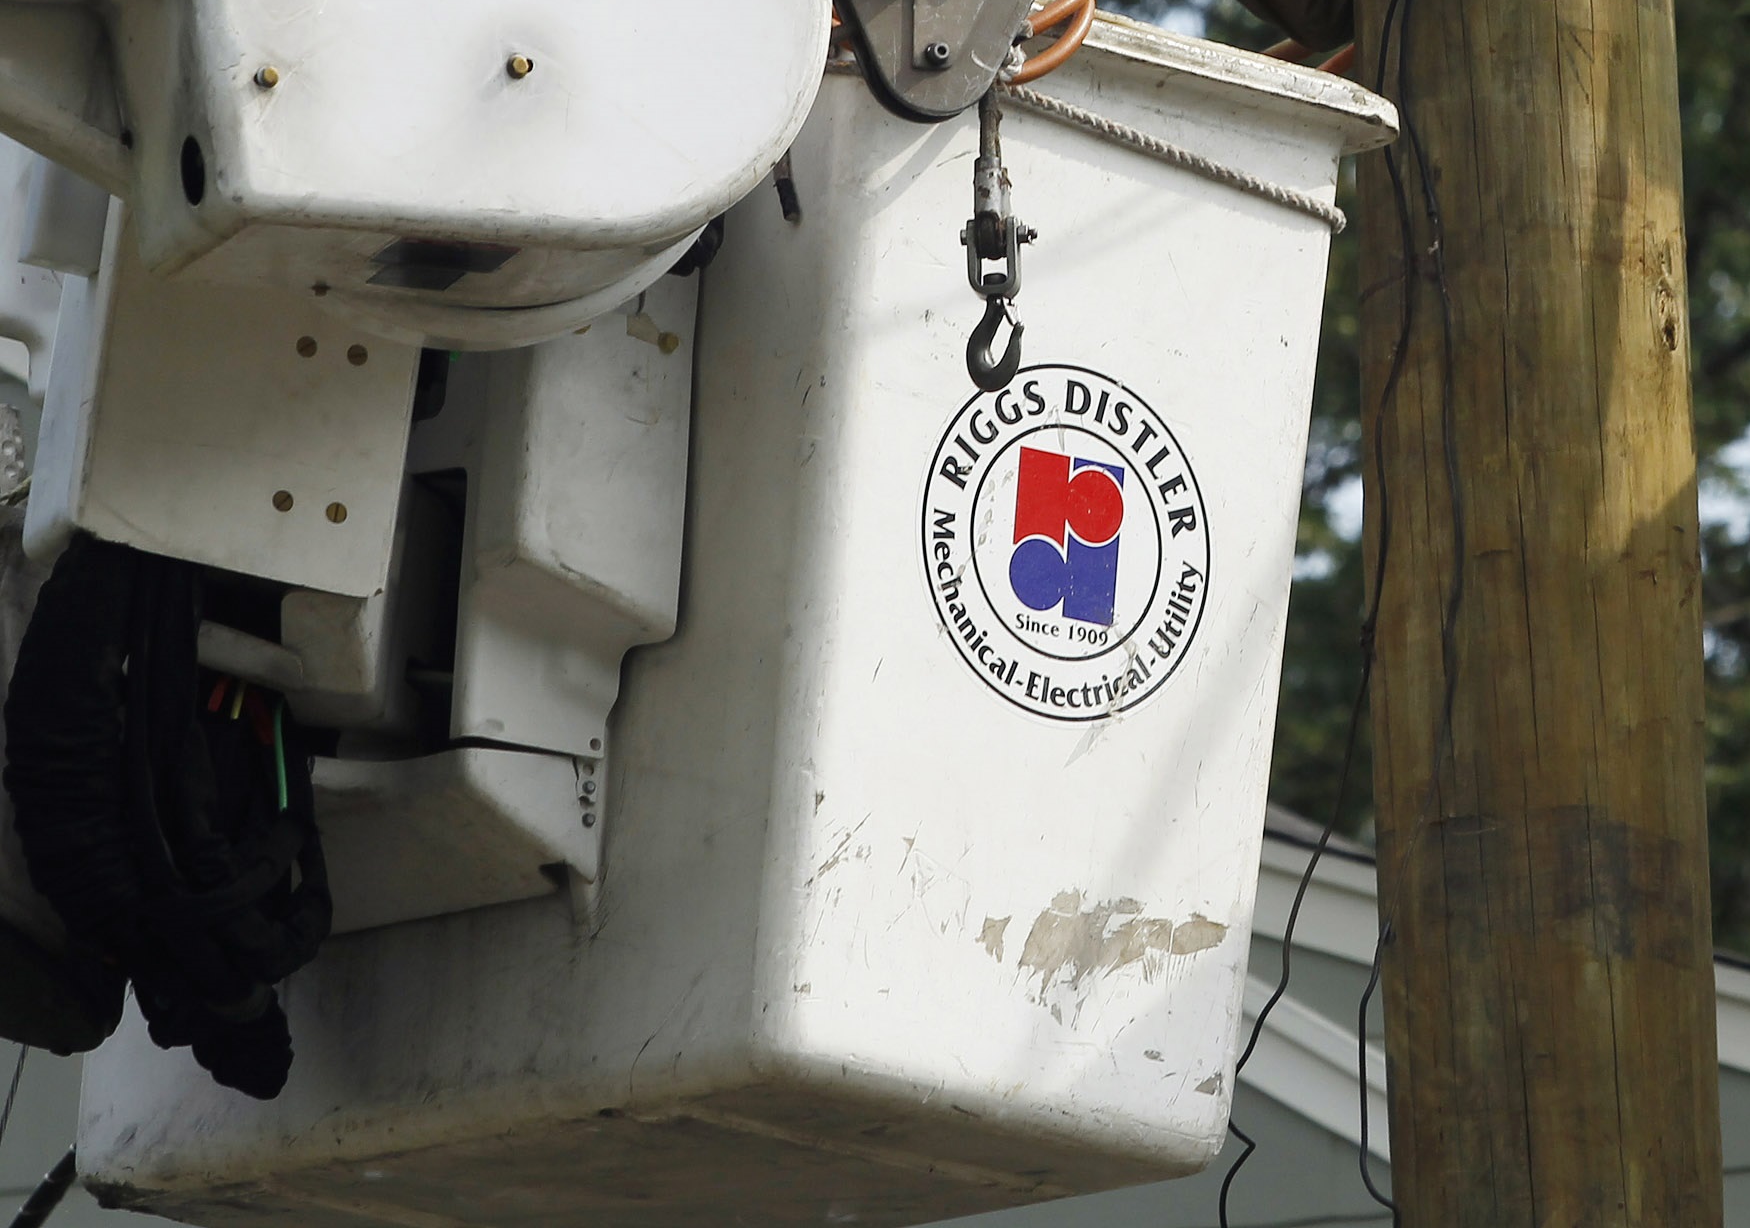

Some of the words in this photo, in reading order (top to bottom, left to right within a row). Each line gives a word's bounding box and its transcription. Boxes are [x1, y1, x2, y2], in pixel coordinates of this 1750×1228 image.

[940, 379, 1046, 491] RIGGS
[1063, 378, 1197, 539] DISTLER
[1015, 612, 1060, 638] Since
[1067, 625, 1109, 647] 1909
